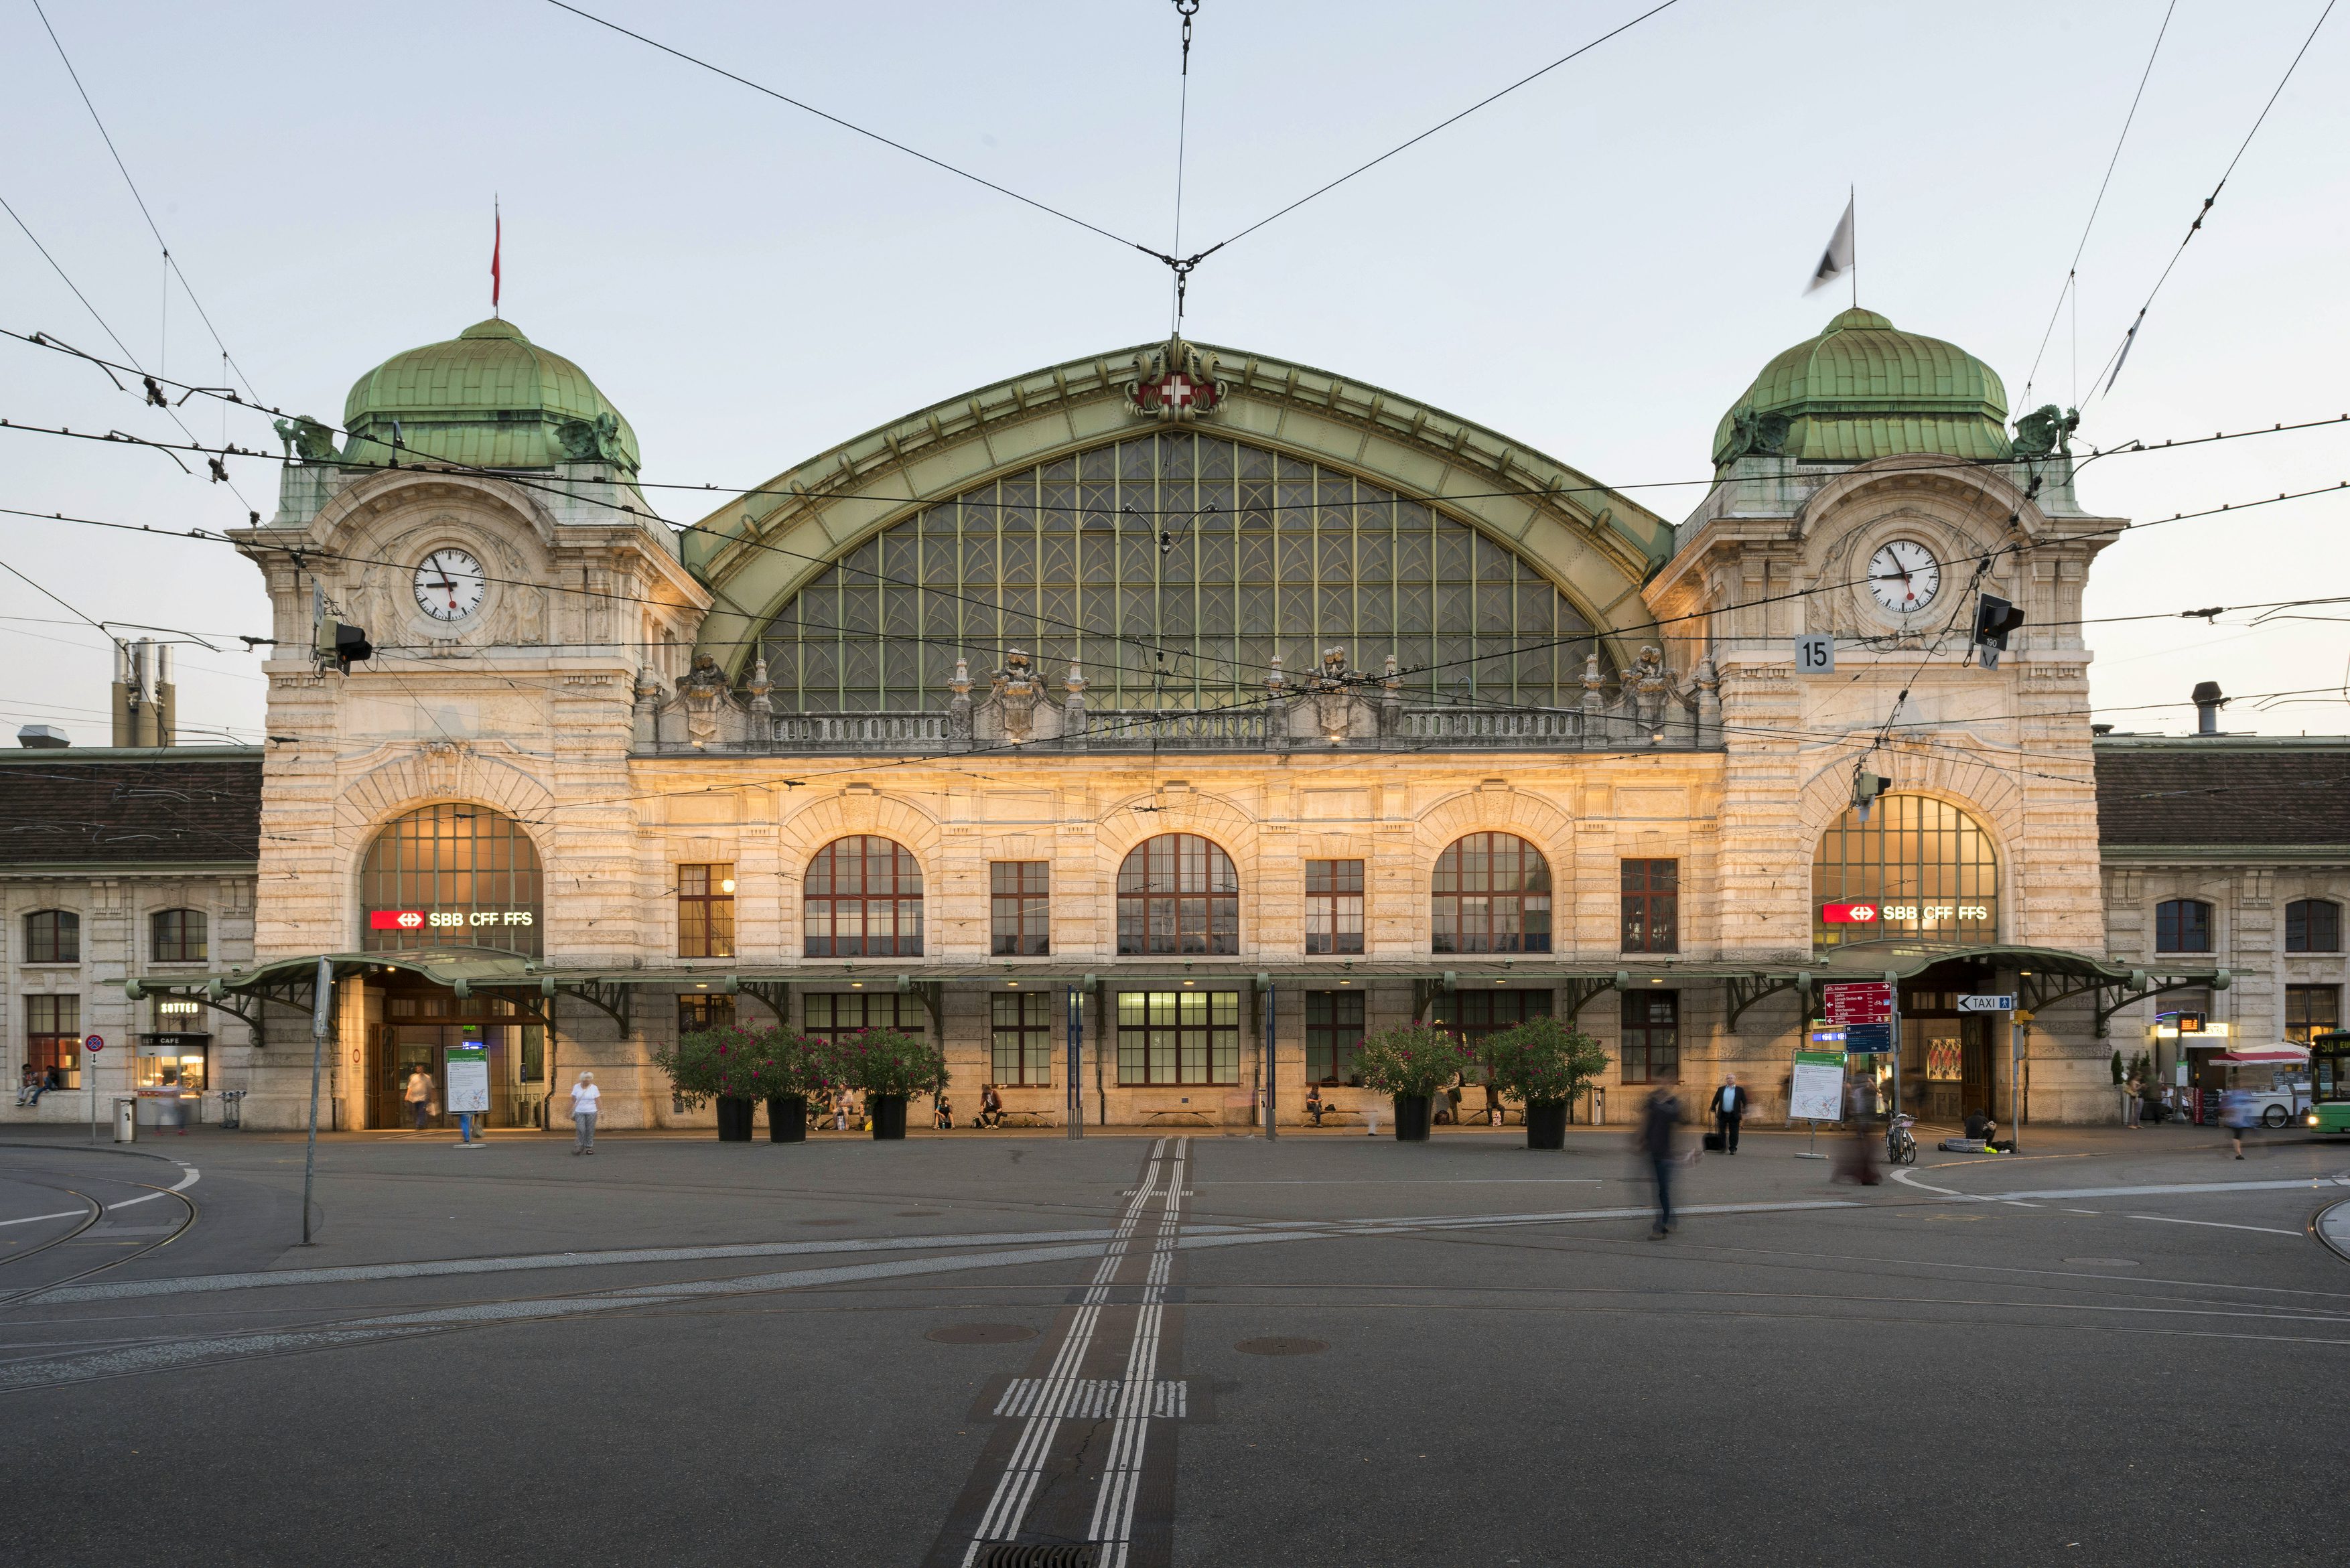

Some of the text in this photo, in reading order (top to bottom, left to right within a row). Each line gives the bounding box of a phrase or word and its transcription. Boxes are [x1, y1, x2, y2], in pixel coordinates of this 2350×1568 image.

[316, 590, 323, 620] 15
[1986, 638, 1998, 648] 190
[1803, 642, 1827, 666] 15
[429, 912, 533, 927] SBB CFF FFS
[1883, 906, 1987, 920] SBB CFF FFS
[1973, 998, 1995, 1008] TAXI
[2321, 1040, 2334, 1053] 50
